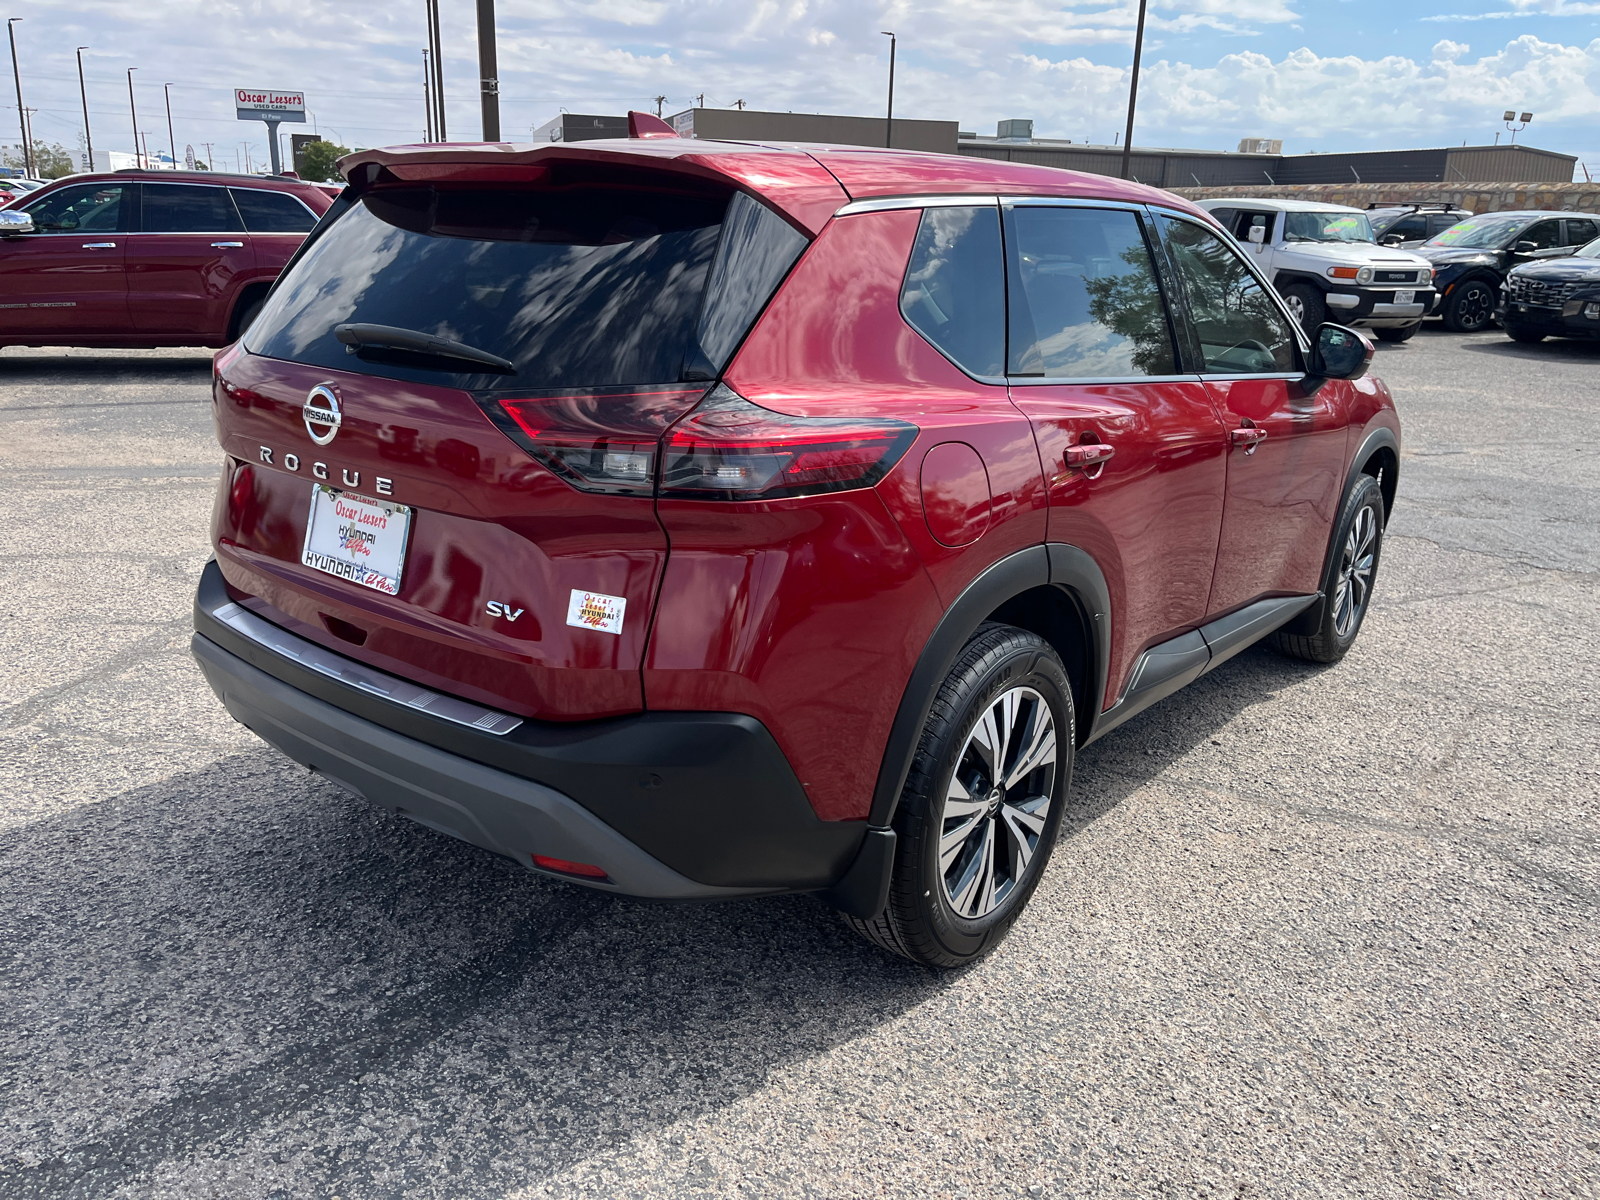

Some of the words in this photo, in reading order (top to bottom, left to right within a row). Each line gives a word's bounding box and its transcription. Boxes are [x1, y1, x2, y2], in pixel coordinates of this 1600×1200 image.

[238, 90, 266, 103] Oscar
[269, 93, 302, 105] Leeser's
[303, 408, 336, 424] NISSAN
[259, 445, 394, 496] ROGUE
[342, 491, 358, 501] Oscar
[335, 500, 358, 521] Oscar
[358, 508, 387, 530] Leeser's
[338, 525, 376, 545] HYUNDAI
[305, 551, 355, 580] HYUNDAI
[365, 573, 379, 585] El
[376, 576, 394, 594] Paso
[580, 601, 614, 613] Leeser's
[584, 592, 613, 605] Oscar
[485, 600, 525, 622] SV
[581, 609, 615, 620] HYUNDAI
